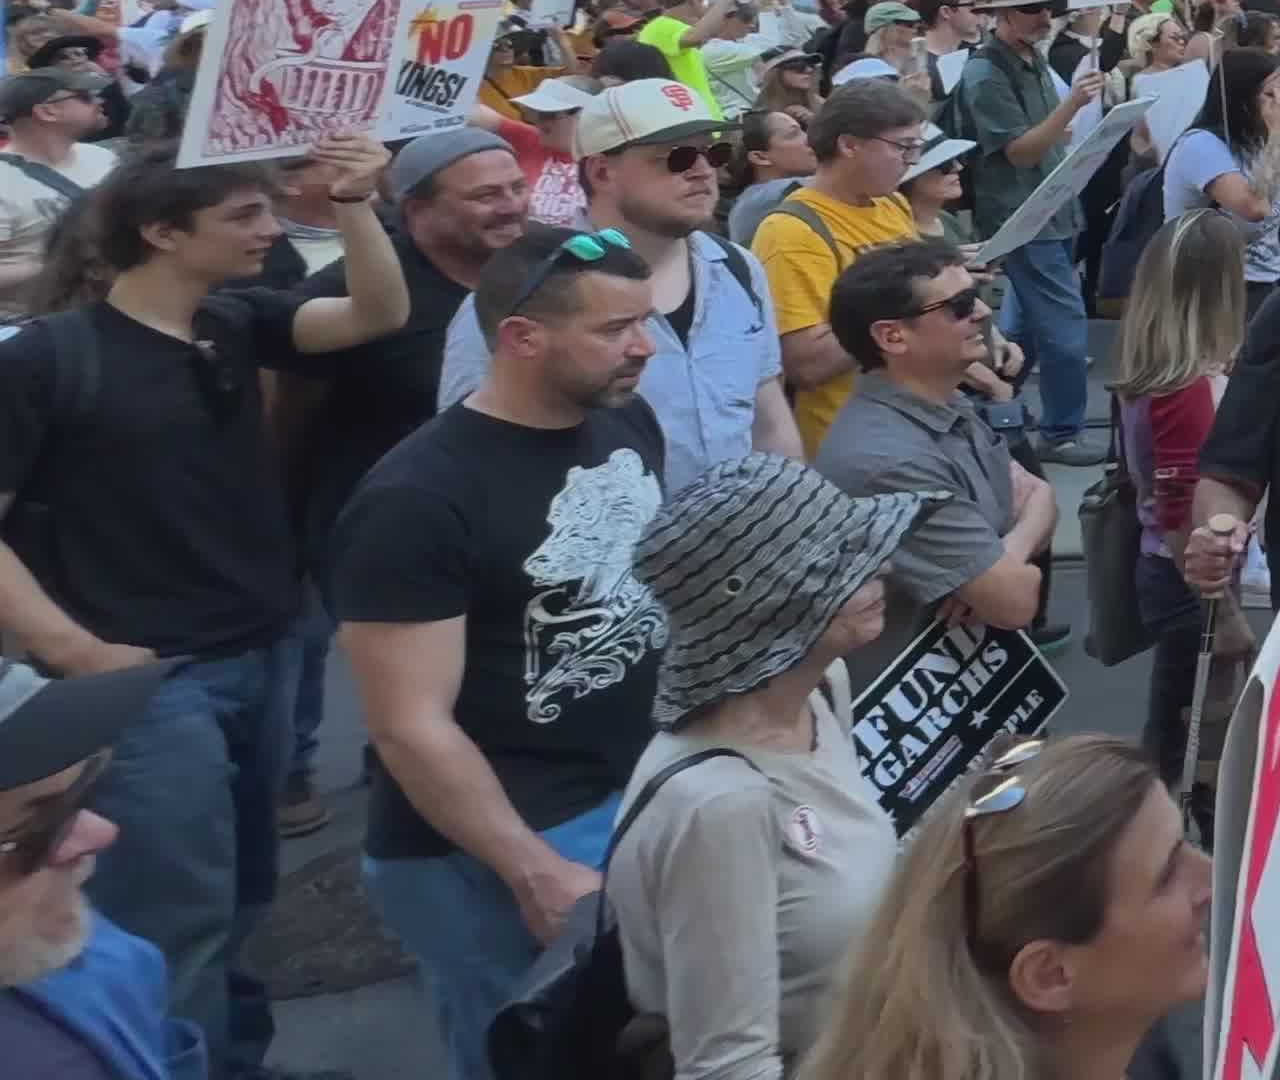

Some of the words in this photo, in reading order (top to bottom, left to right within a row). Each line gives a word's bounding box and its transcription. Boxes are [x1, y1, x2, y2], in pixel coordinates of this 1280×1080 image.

[416, 13, 475, 66] NO
[851, 623, 987, 761] FUND
[861, 640, 1008, 800] IGARCHS
